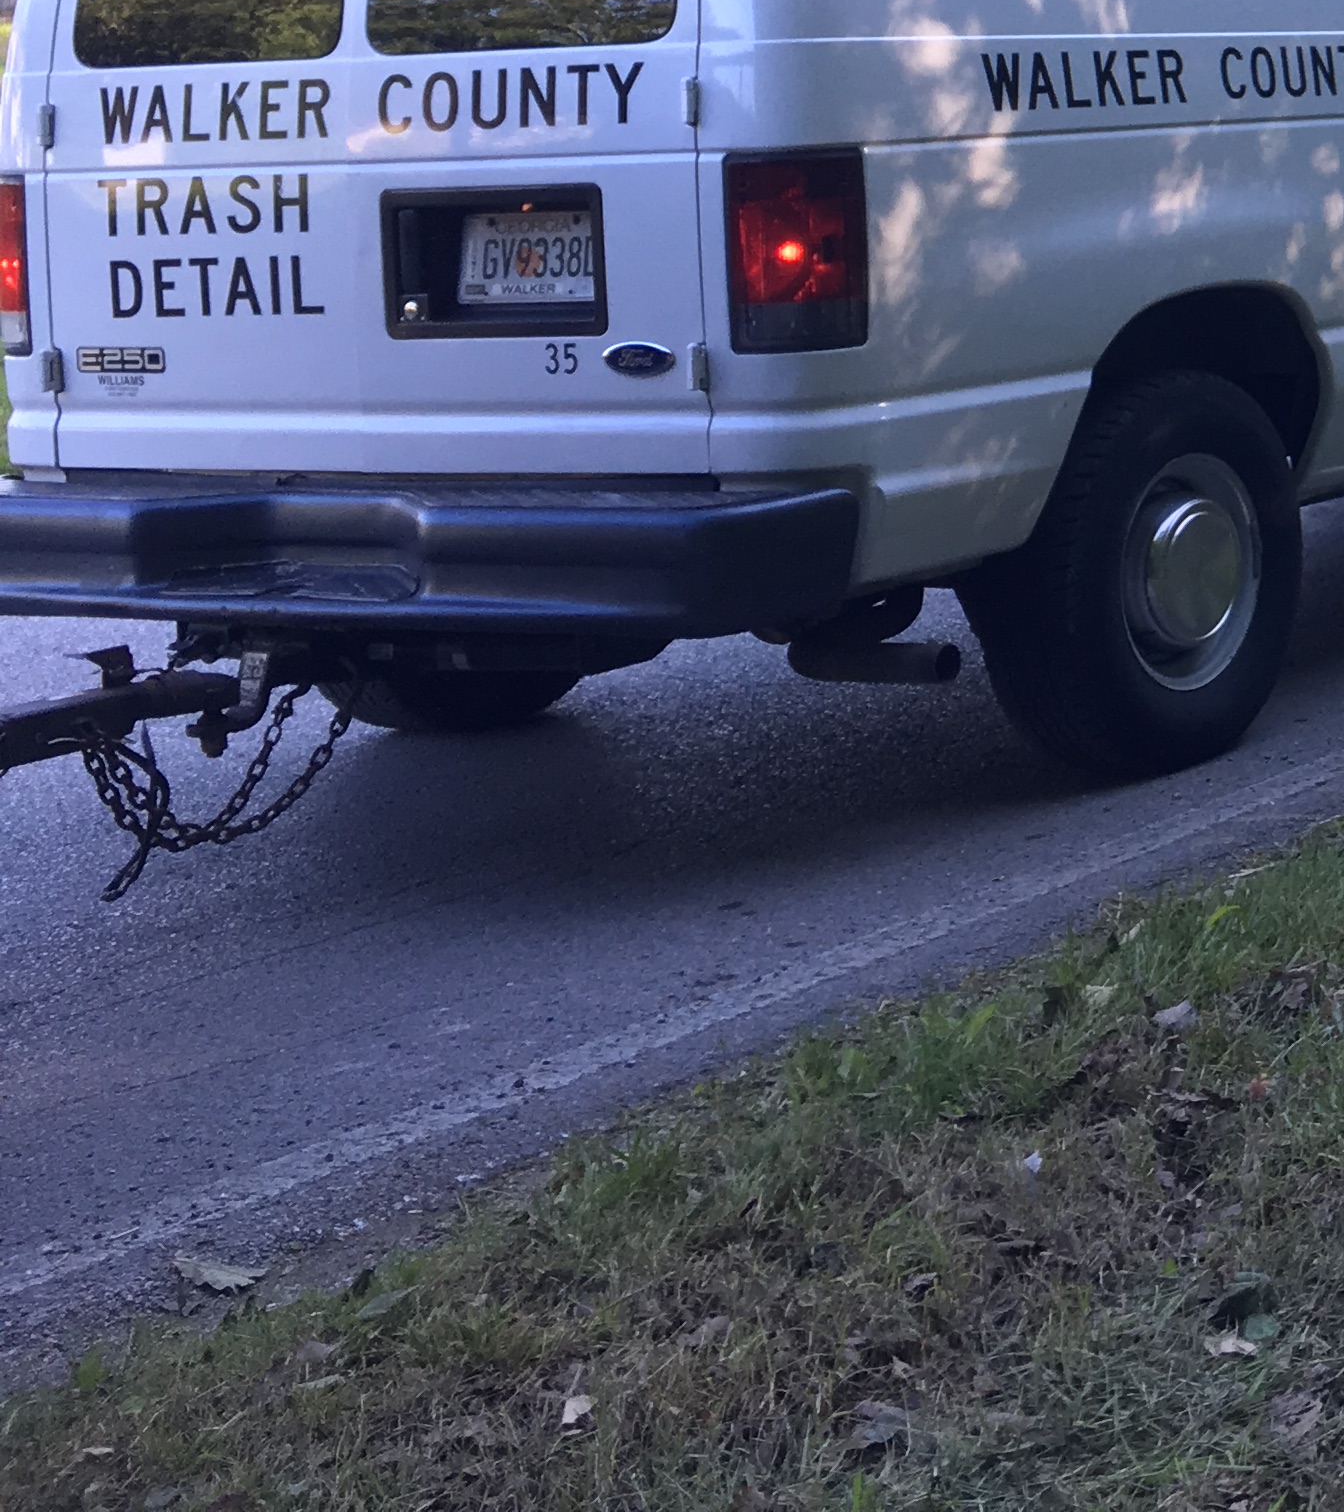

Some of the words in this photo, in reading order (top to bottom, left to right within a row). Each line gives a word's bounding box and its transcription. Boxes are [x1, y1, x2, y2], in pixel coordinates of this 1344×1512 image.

[981, 49, 1188, 112] WALKER
[100, 78, 332, 145] WALKER
[378, 62, 645, 135] COUNTY
[98, 173, 310, 237] TRASH
[495, 217, 572, 235] GEORGIA
[109, 255, 326, 319] DETAIL
[502, 283, 556, 295] WALKER
[544, 342, 579, 375] 35
[617, 348, 654, 368] Ford
[97, 374, 146, 387] WILLIAMS
